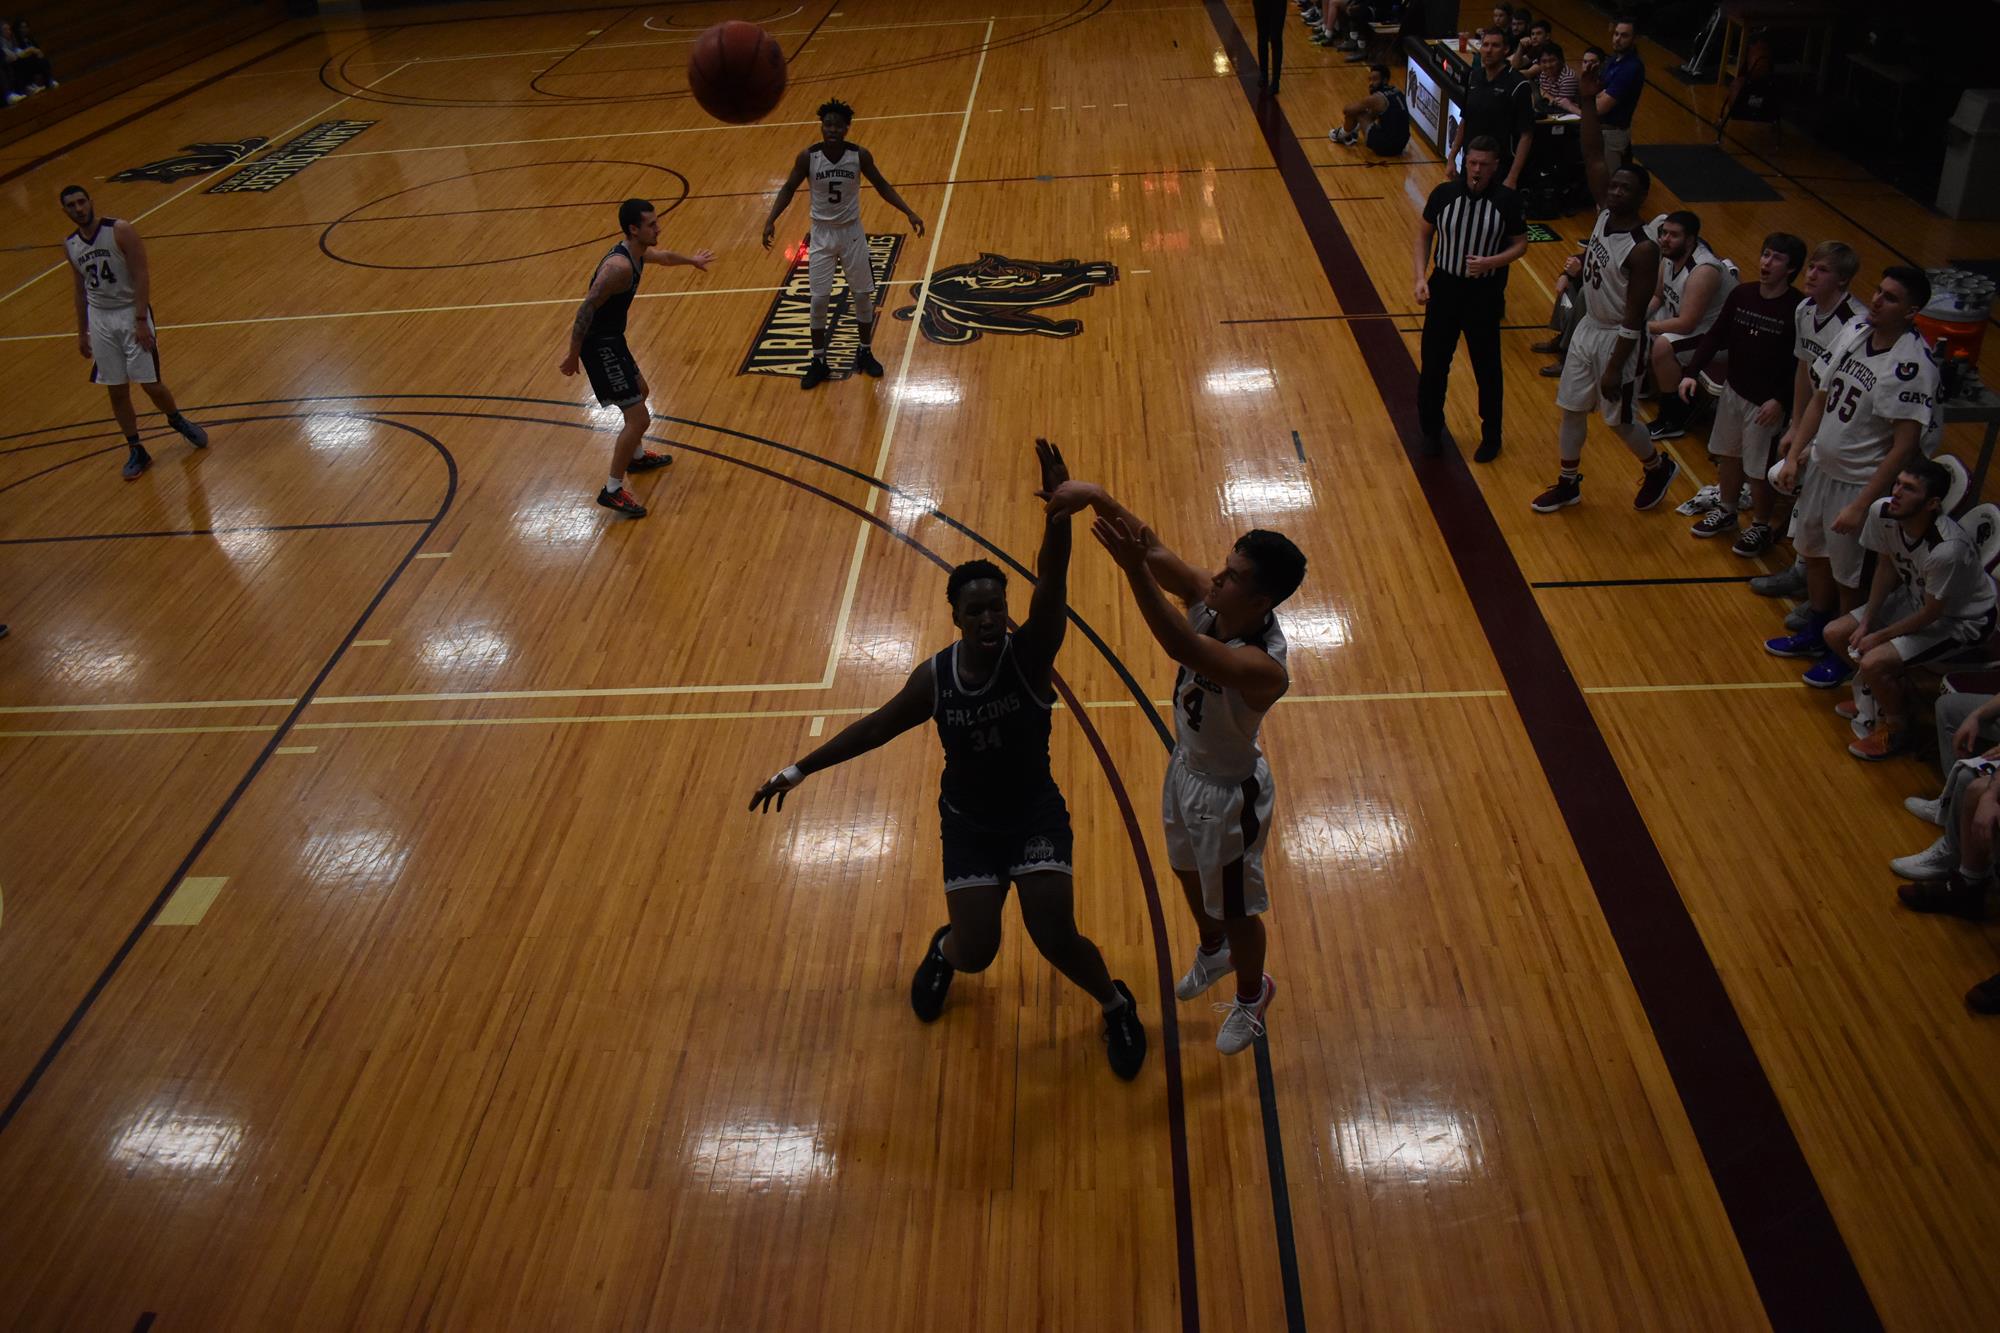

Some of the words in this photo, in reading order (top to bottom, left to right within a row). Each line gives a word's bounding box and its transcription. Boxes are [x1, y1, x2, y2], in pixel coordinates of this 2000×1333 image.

[816, 169, 855, 180] PANTHERS
[828, 181, 842, 204] 5
[78, 248, 111, 265] PANTHERS
[1583, 250, 1603, 290] 55
[86, 260, 117, 288] 34
[597, 346, 630, 393] FALCONS
[1827, 377, 1862, 423] 35
[945, 692, 1020, 727] FALCONS
[969, 726, 1003, 753] 34
